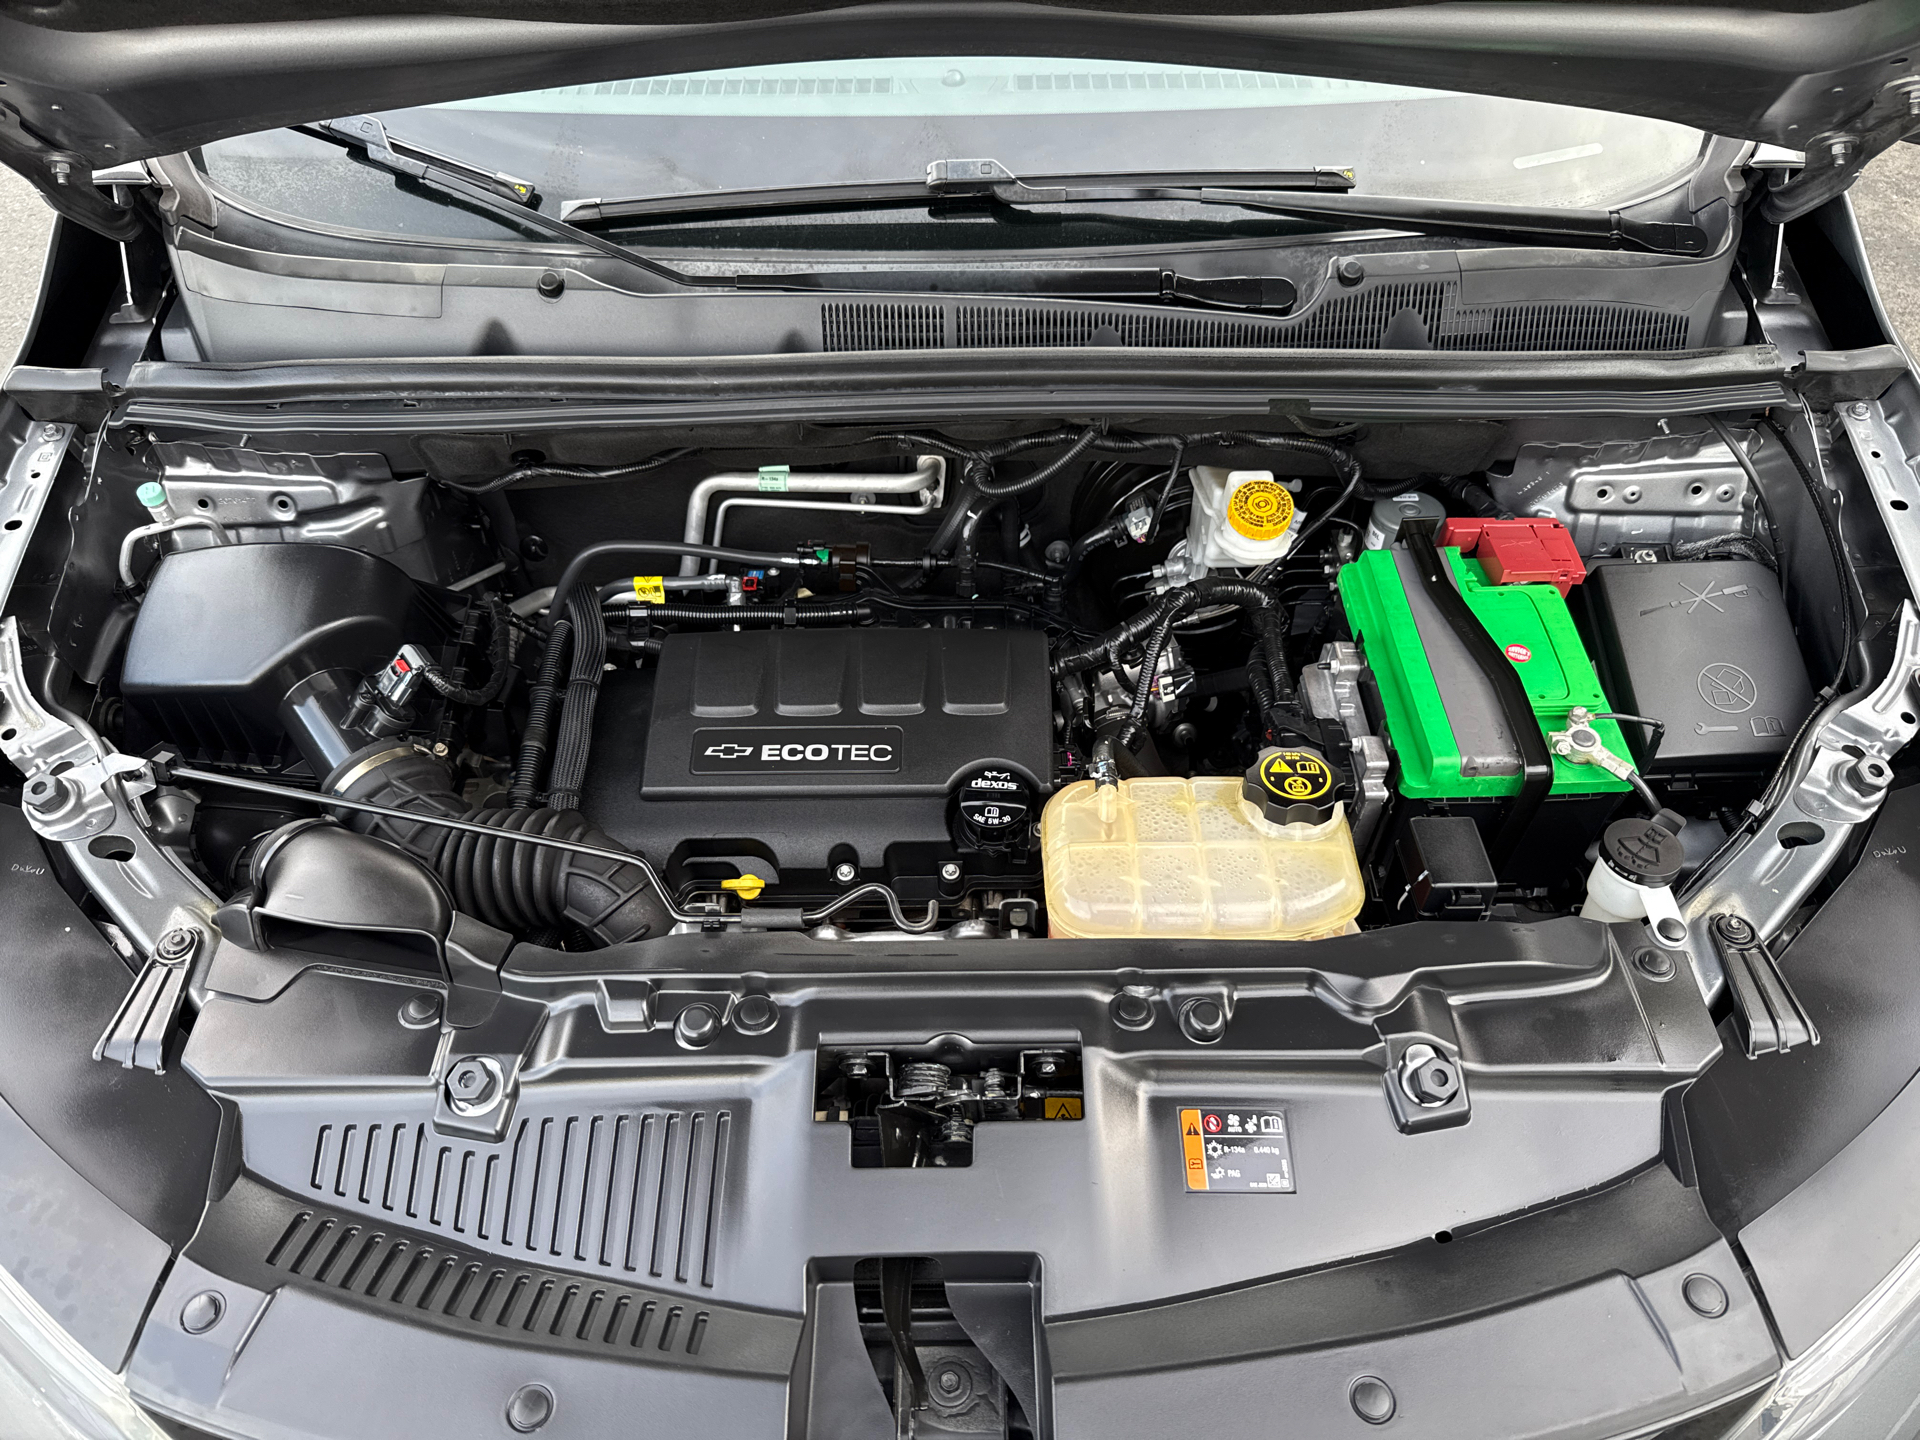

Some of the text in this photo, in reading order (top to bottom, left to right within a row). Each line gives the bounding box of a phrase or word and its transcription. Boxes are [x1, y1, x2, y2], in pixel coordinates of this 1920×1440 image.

[761, 744, 893, 762] ECOTEC
[971, 778, 1019, 790] dexos
[973, 813, 1011, 825] SAE 5W-30
[1223, 1145, 1246, 1154] R-134a
[1271, 1146, 1280, 1156] kg
[1227, 1169, 1241, 1178] PAG
